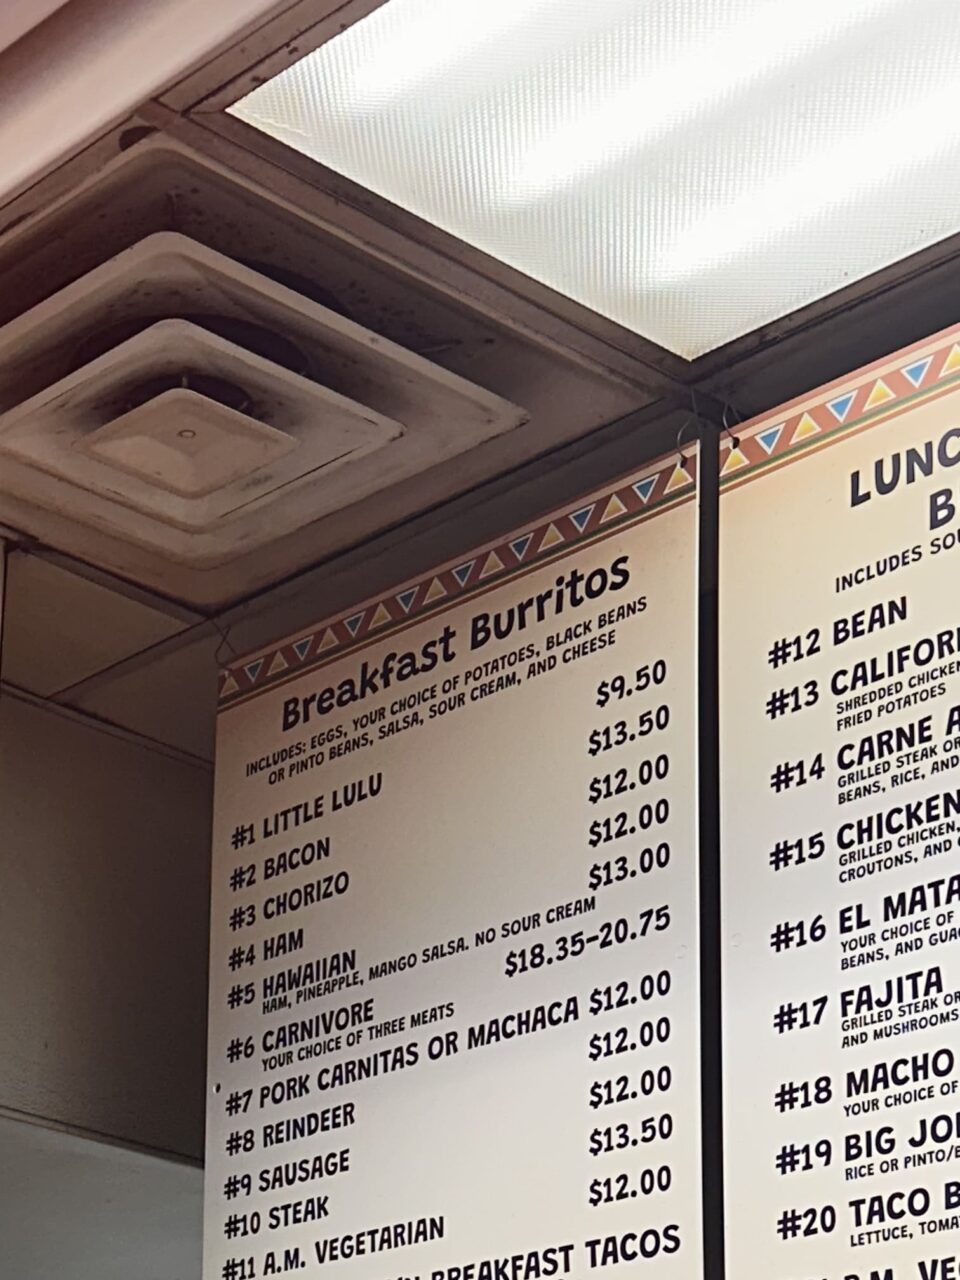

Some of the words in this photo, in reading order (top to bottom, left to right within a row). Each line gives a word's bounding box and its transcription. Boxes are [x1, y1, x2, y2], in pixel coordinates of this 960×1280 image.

[282, 625, 456, 732] Breakfast
[470, 555, 630, 651] Burritos
[768, 627, 821, 669] #12
[833, 595, 907, 646] BEAN
[246, 741, 306, 777] INCLUDES:
[310, 724, 348, 750] EGGS,
[352, 706, 386, 731] YOUR
[390, 684, 437, 716] CHOICE
[441, 674, 460, 694] OF
[464, 643, 540, 686] POTATOES,
[545, 619, 592, 651] BLACK
[597, 596, 647, 629] BEANS
[268, 767, 285, 785] OR
[288, 751, 324, 778] PINTO
[328, 732, 373, 760] BEANS,
[378, 711, 424, 740] SALSA,
[428, 692, 465, 719] SOUR
[470, 671, 521, 701] CREAM,
[526, 654, 557, 680] AND
[562, 629, 616, 664] CHEESE
[596, 659, 666, 708] $9.50
[836, 680, 903, 715] SHREDDED
[908, 659, 960, 689] CHICKE
[836, 708, 872, 731] FRIED
[877, 682, 946, 717] POTATOES
[588, 753, 669, 804] $12.00
[770, 752, 825, 793] #14
[837, 715, 933, 770] CARNE
[231, 823, 255, 850] #1
[263, 794, 324, 839] LITTLE
[331, 772, 382, 812] LULU
[588, 842, 670, 891] $13.00
[229, 904, 256, 932] #3
[263, 870, 349, 920] CHORIZO
[840, 932, 876, 953] YOUR
[880, 916, 930, 942] CHOICE
[935, 910, 954, 927] OF
[262, 994, 292, 1015] HAM,
[296, 970, 364, 1004] PINEAPPLE,
[368, 952, 417, 981] MANGO
[475, 927, 496, 947] NO
[501, 912, 541, 938] SOUR
[545, 895, 596, 924] CREAM
[504, 904, 670, 978] $18.35-20.75
[227, 981, 256, 1010] #5
[262, 949, 356, 999] HAWAIIAN
[588, 969, 671, 1016] $12.00
[773, 995, 828, 1034] #17
[840, 966, 943, 1018] FAJITA
[225, 1088, 253, 1117] #7
[259, 1073, 310, 1109] PORK
[317, 1042, 419, 1091] CARNITAS
[427, 1030, 458, 1060] OR
[467, 995, 579, 1050] MACHACA
[226, 1035, 255, 1063] #6
[262, 997, 374, 1053] CARNIVORE
[261, 1050, 293, 1072] YOUR
[297, 1035, 341, 1061] CHOICE
[346, 1029, 363, 1047] OF
[367, 1016, 405, 1040] THREE
[410, 1002, 454, 1028] MEATS
[841, 1031, 868, 1049] AND
[873, 1008, 959, 1041] MUSHROOMS
[774, 1075, 832, 1113] #18
[846, 1048, 954, 1098] MACHO
[588, 1113, 672, 1156] $13.50
[588, 1165, 671, 1207] $12.00
[776, 1204, 836, 1240] #20
[848, 1187, 930, 1227] TACO
[223, 1211, 260, 1240] #10
[268, 1195, 329, 1230] STEAK
[262, 1247, 306, 1276] A.M.
[314, 1215, 444, 1264] VEGETARIAN
[584, 1224, 680, 1268] TACOS
